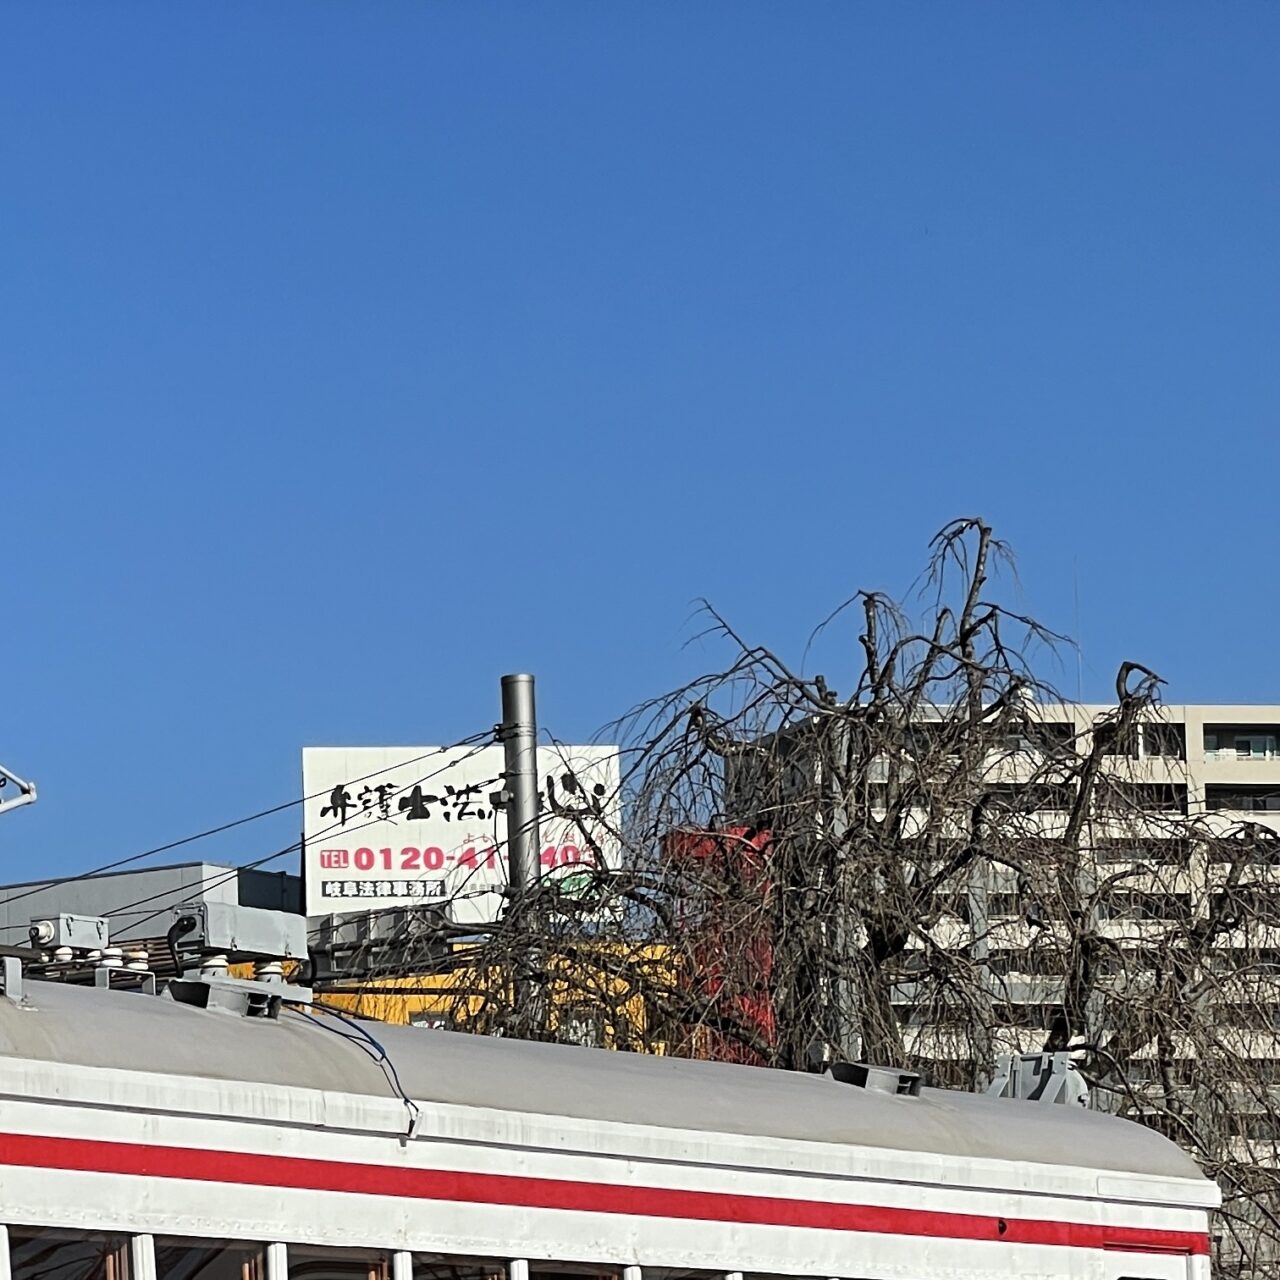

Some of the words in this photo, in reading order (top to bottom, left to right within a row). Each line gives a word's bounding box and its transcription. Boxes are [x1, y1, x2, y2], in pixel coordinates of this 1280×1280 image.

[322, 851, 348, 867] TEL
[325, 881, 442, 896] 岐阜法律事務所
